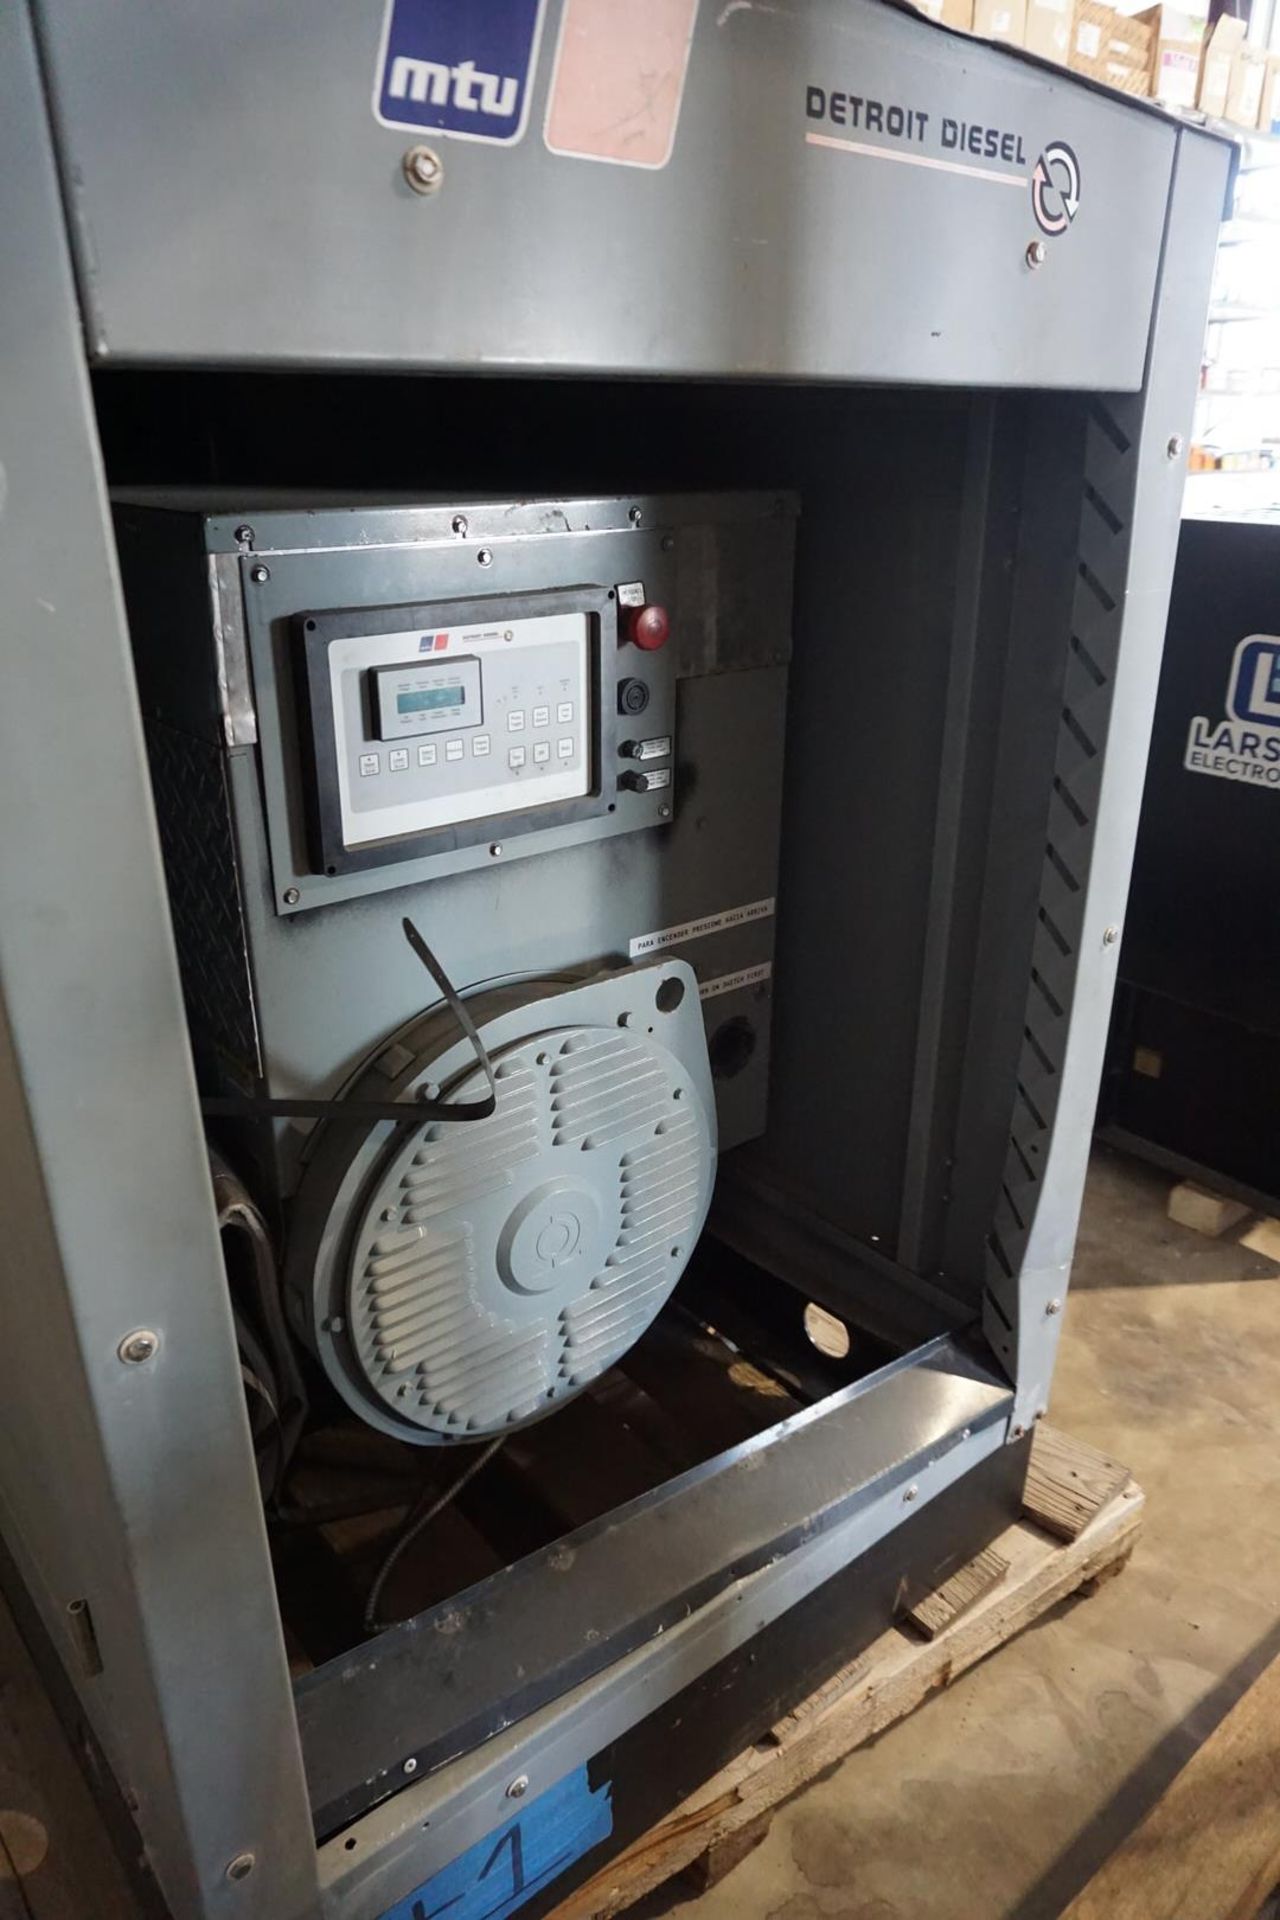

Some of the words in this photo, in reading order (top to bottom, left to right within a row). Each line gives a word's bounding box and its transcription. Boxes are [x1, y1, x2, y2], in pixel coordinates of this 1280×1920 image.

[389, 55, 519, 117] mtu
[805, 85, 929, 142] DETROIT
[940, 117, 1027, 165] DIESEL
[637, 940, 655, 950] PARA
